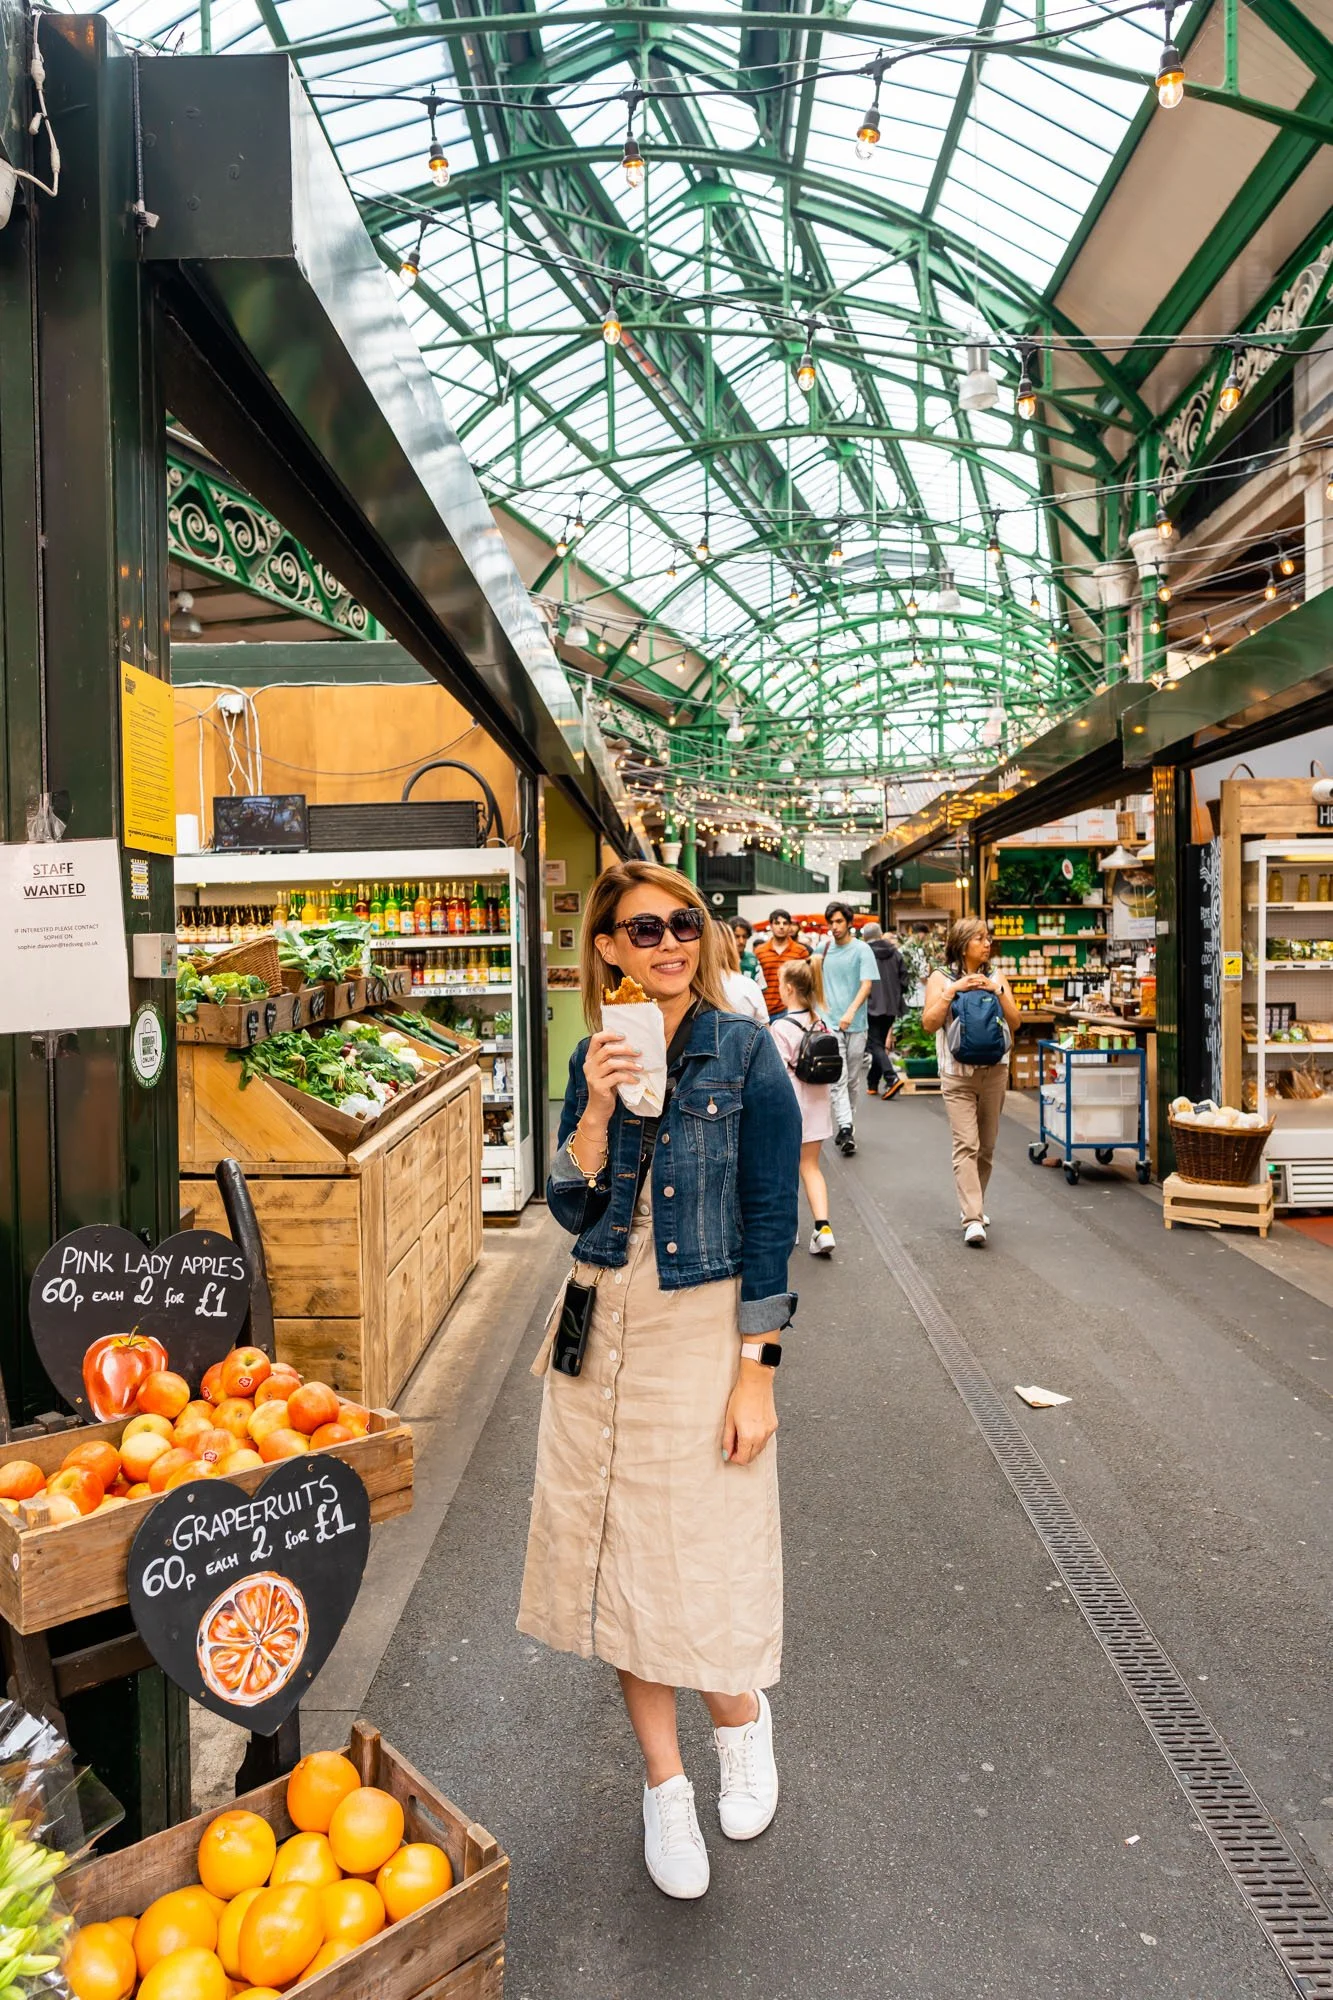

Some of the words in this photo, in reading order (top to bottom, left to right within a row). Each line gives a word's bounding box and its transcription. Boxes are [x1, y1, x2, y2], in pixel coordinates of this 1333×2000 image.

[33, 862, 74, 876] STAFF
[23, 883, 86, 897] WANTED
[60, 1246, 114, 1275] PINK
[124, 1252, 174, 1280] LADY
[180, 1255, 245, 1281] APPLES
[41, 1277, 84, 1312] 60p
[92, 1290, 124, 1302] EACH
[133, 1275, 154, 1305] 2
[194, 1281, 228, 1317] £1
[172, 1474, 339, 1551] GRAPEFRUITS
[142, 1555, 196, 1597] 60p
[205, 1553, 239, 1576] EACH
[250, 1525, 273, 1563] 2
[314, 1503, 356, 1543] £1
